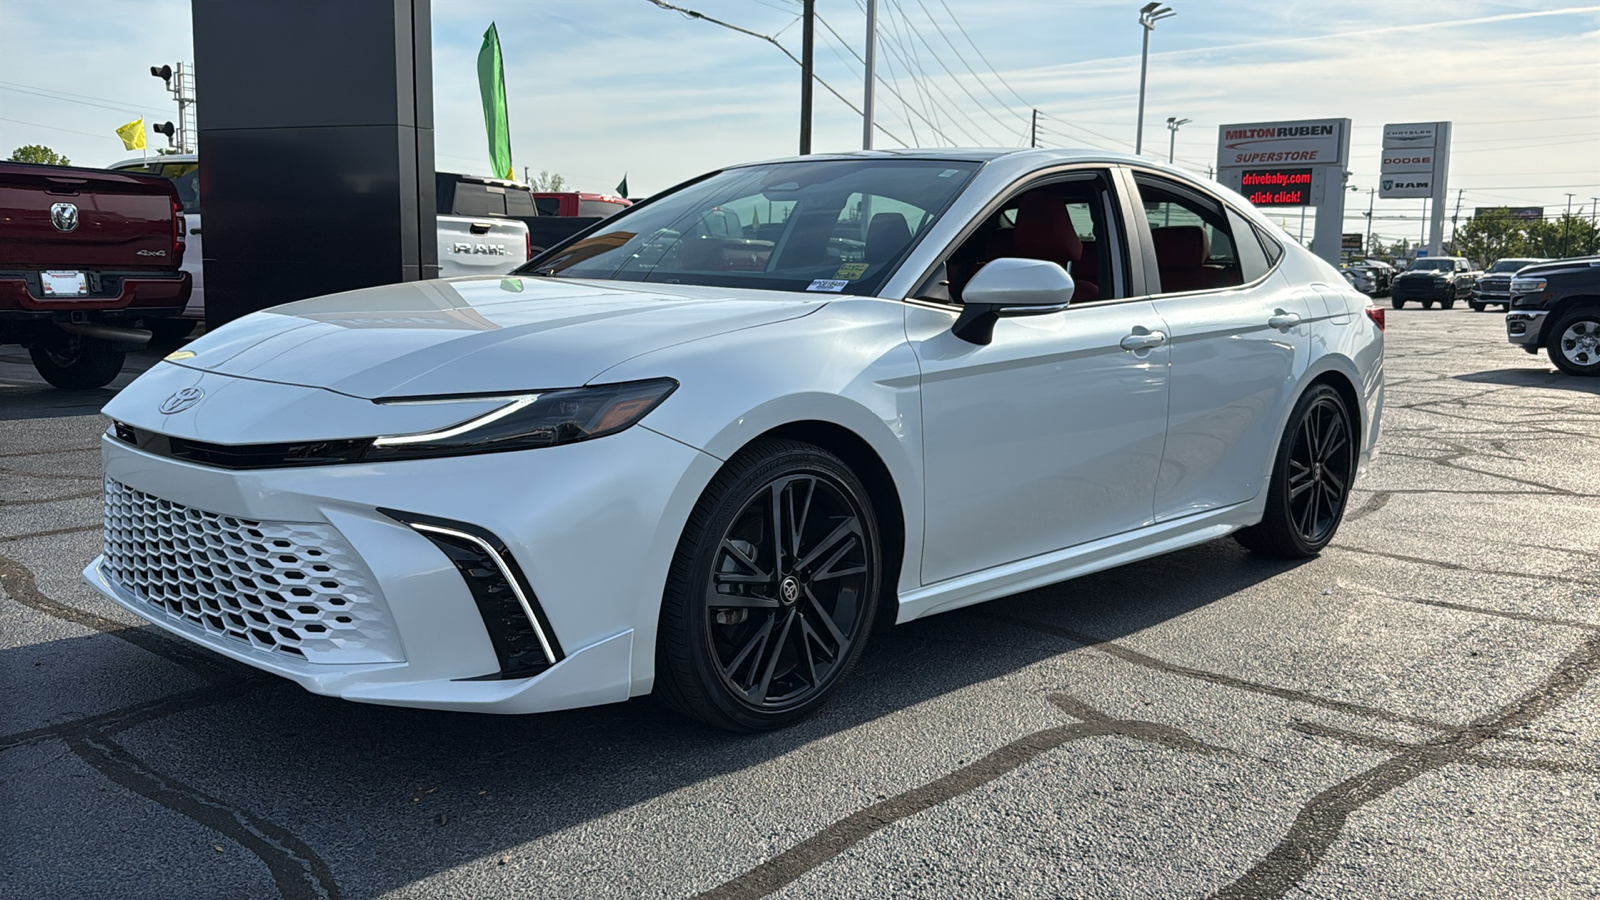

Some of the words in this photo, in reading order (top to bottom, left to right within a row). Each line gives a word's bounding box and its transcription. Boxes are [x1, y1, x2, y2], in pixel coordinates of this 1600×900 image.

[1225, 128, 1275, 140] MILTON
[1276, 125, 1333, 137] RUBEN
[1235, 151, 1318, 163] SUPERSTORE
[1242, 172, 1310, 186] drivebaby.com
[1249, 191, 1272, 203] click
[1274, 191, 1301, 203] click!
[454, 243, 504, 255] RAM
